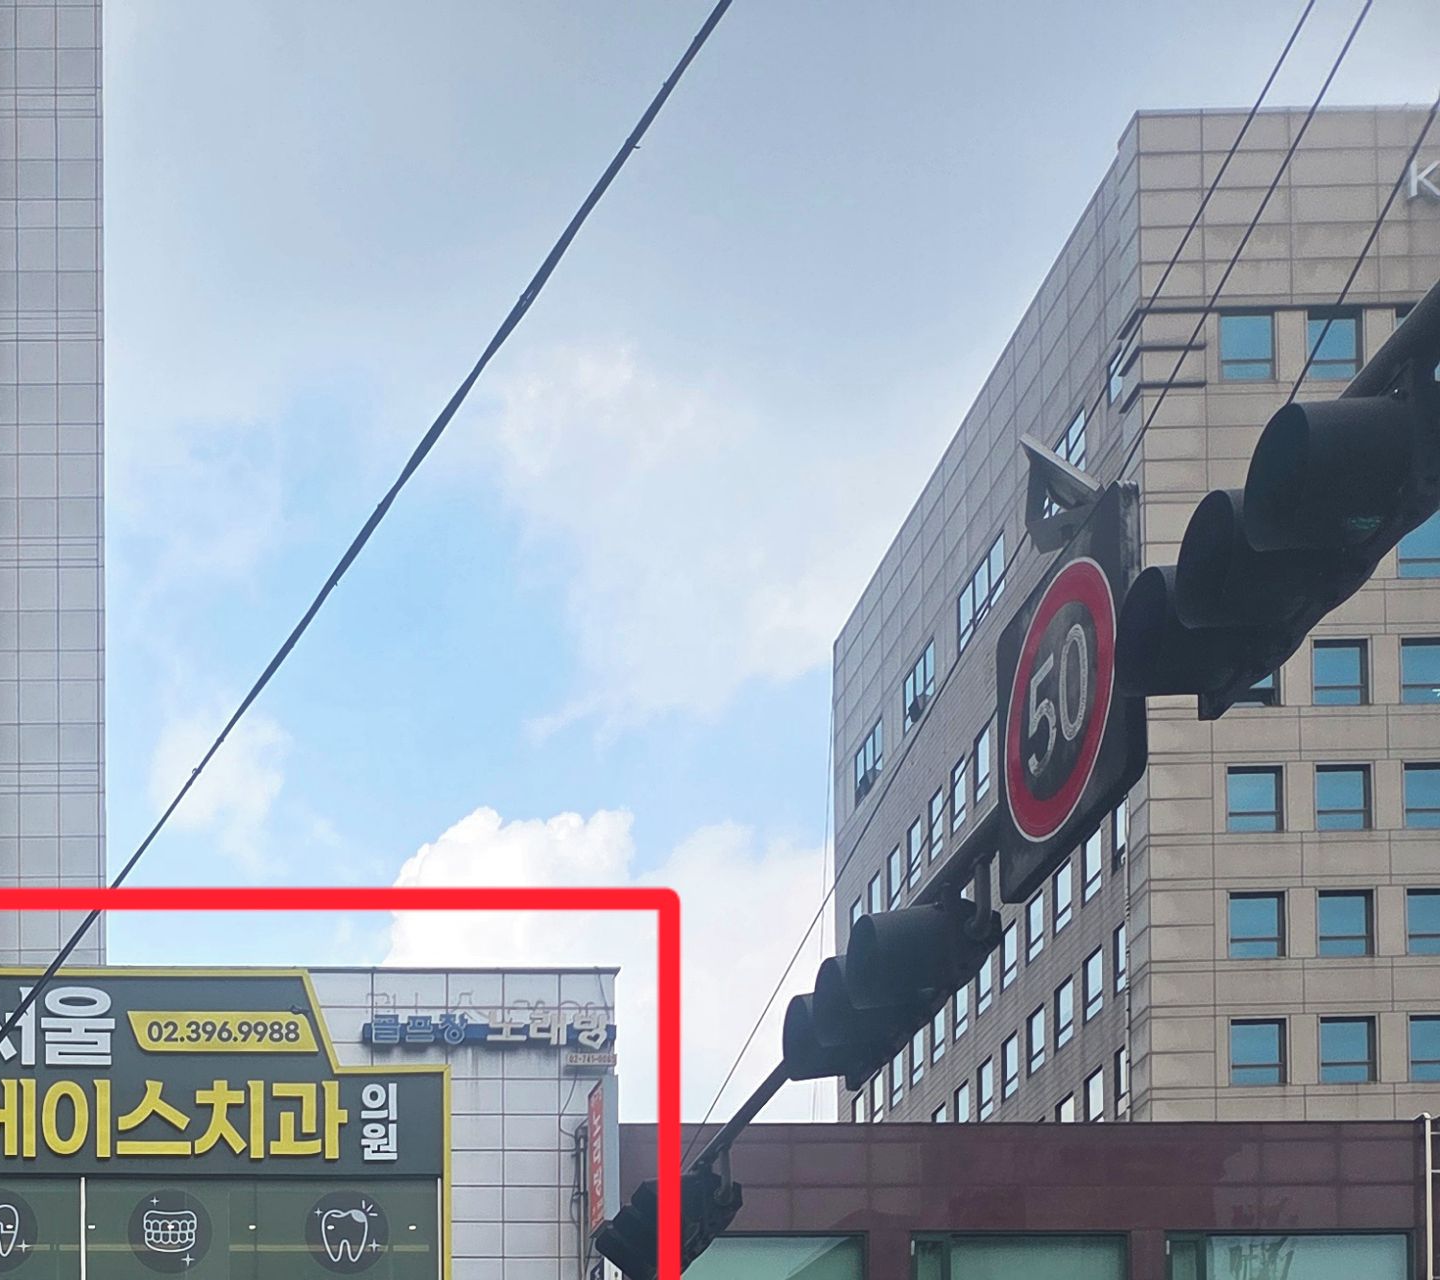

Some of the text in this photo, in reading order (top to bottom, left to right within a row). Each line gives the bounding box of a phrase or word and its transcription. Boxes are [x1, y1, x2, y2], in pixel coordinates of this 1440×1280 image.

[1028, 624, 1087, 776] 50
[147, 1020, 300, 1043] 02.396.9988
[372, 1009, 608, 1050] 골프장 노래방
[361, 1082, 398, 1161] 의원
